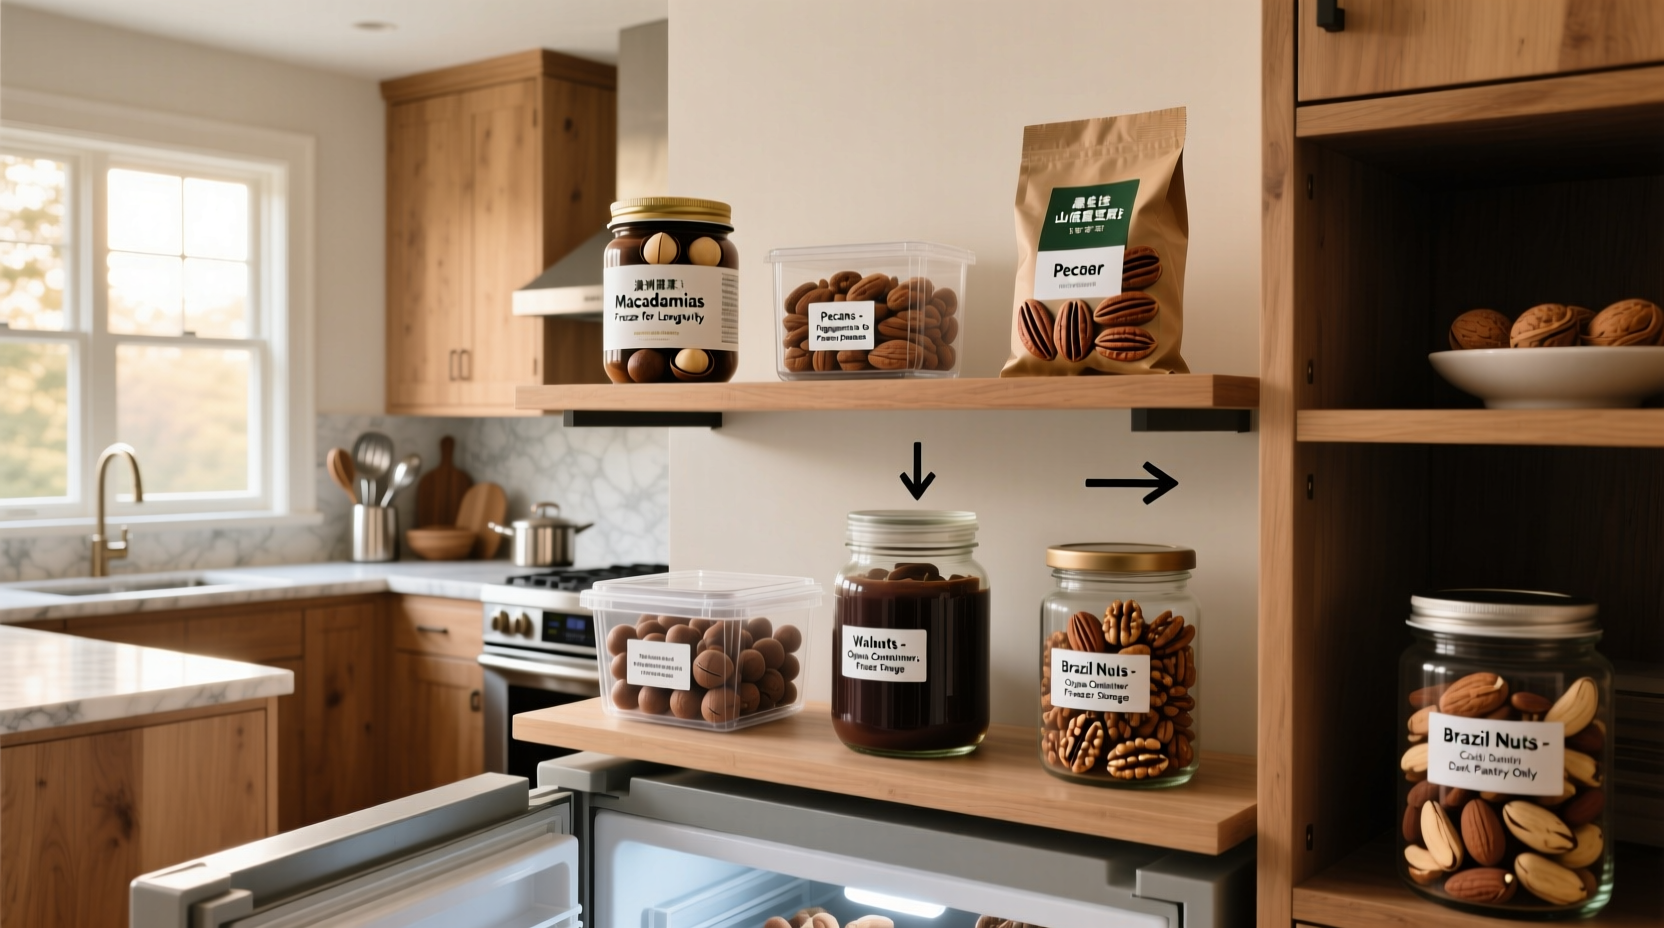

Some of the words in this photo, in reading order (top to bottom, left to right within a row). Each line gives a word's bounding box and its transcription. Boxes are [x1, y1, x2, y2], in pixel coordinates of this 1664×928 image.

[615, 292, 705, 309] Macadamias
[821, 311, 856, 322] Pecans
[1062, 660, 1093, 675] Brazil
[1444, 727, 1490, 747] Brazil
[1495, 731, 1538, 751] Nuts
